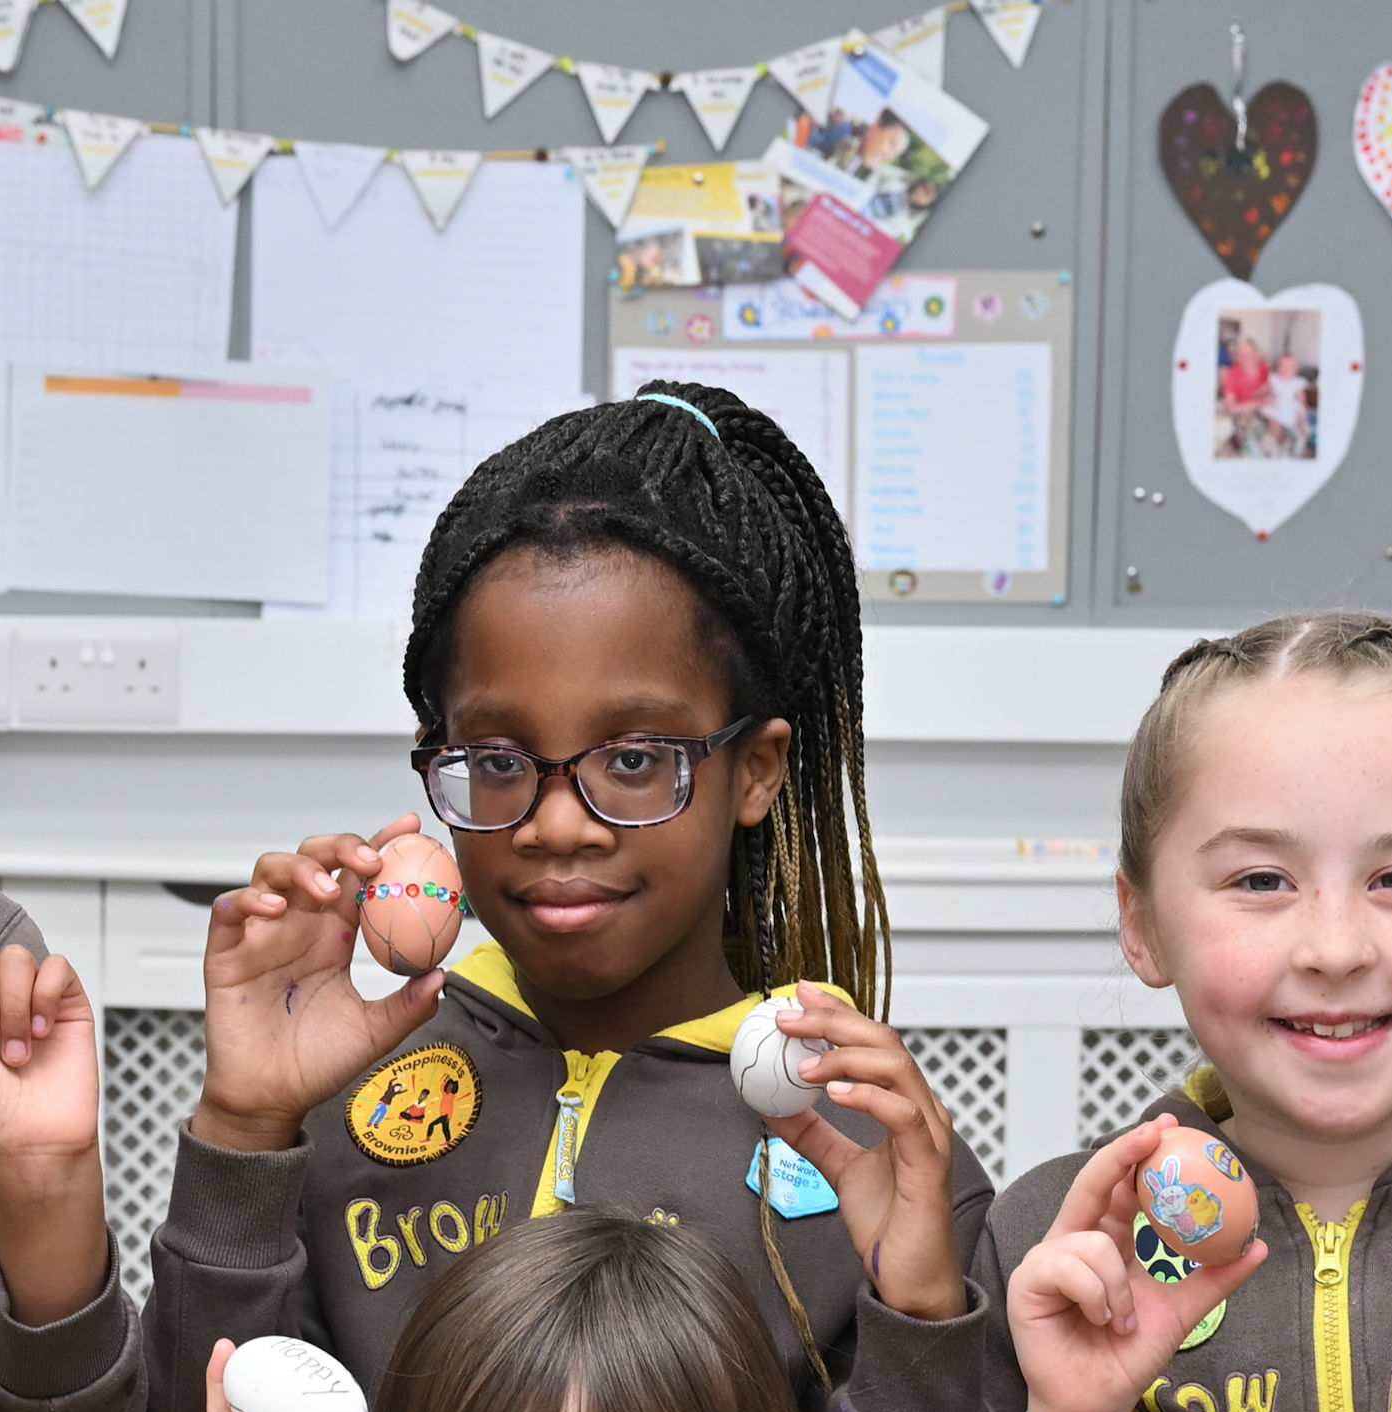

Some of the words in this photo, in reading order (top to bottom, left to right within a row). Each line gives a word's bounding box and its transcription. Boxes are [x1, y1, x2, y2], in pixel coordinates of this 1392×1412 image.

[392, 1053, 459, 1076] Happiness
[455, 1062, 466, 1079] is
[362, 1130, 428, 1156] Brownies
[772, 1167, 810, 1188] Stage
[811, 1180, 821, 1190] 3
[779, 1158, 819, 1178] Network
